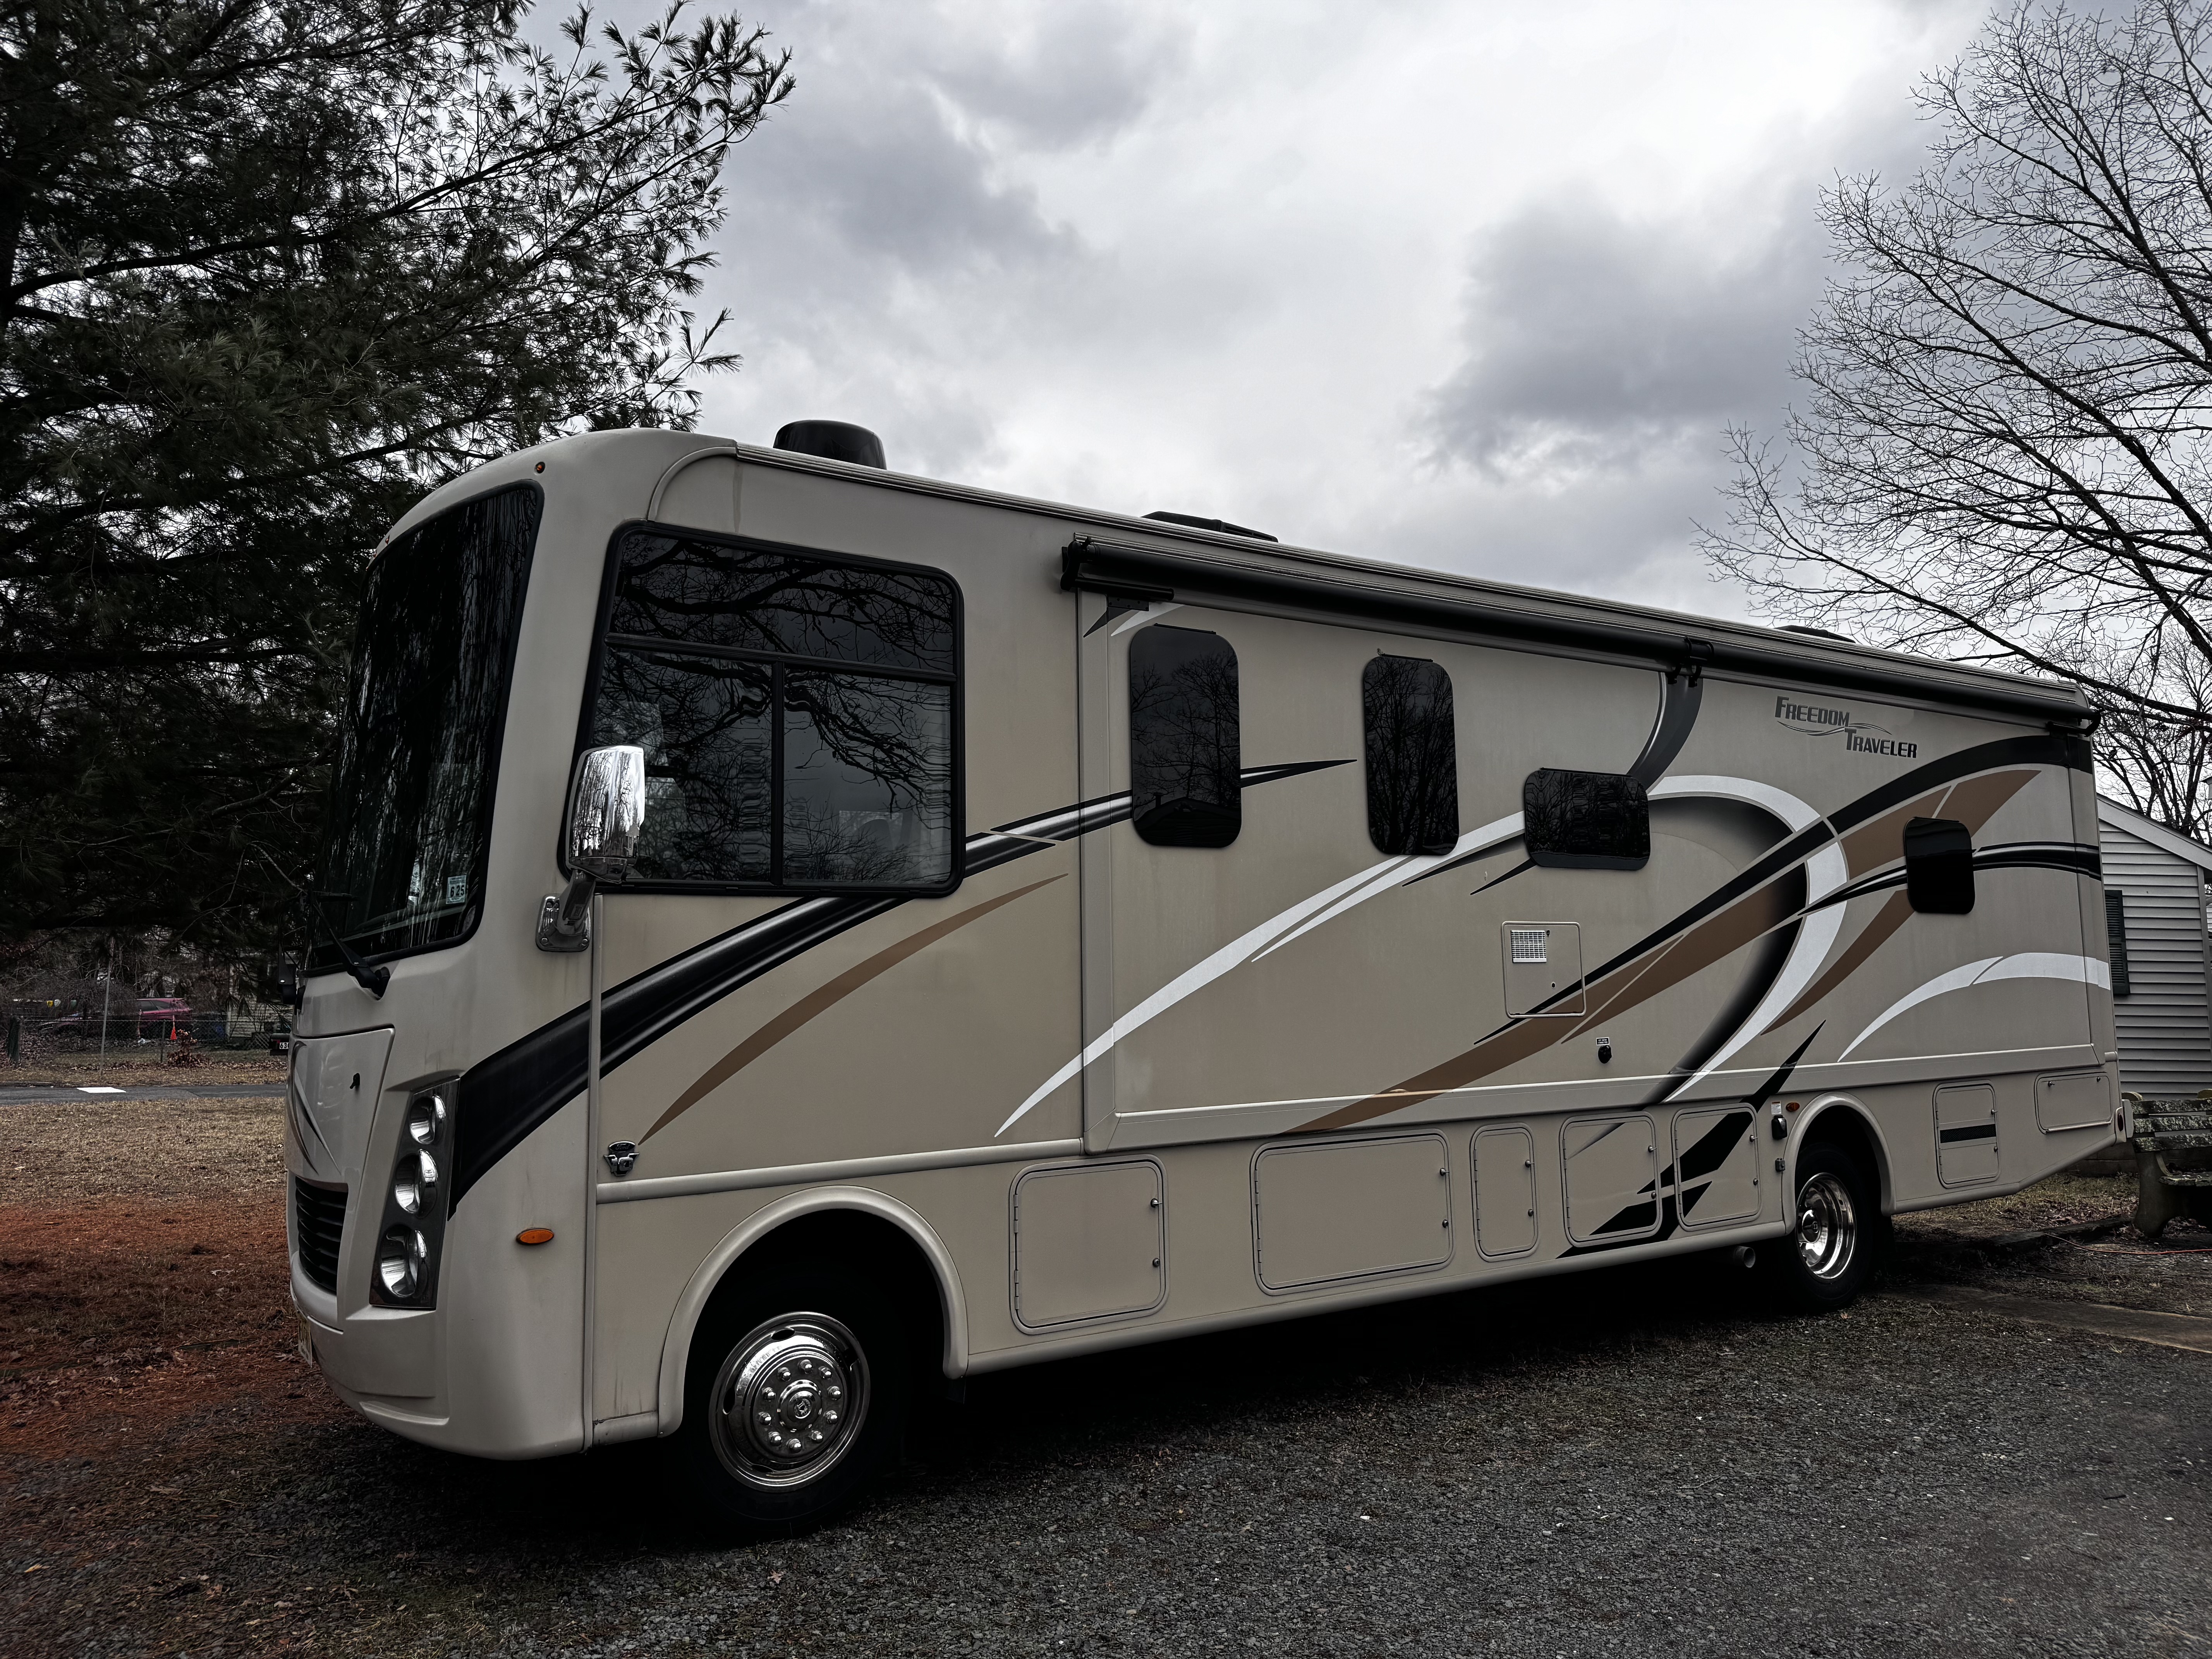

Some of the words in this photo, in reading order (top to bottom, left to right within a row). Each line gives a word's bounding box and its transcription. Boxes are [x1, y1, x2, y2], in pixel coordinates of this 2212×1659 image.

[1775, 696, 1850, 727] FREEDOM
[1844, 727, 1917, 758] TRAVELER
[450, 886, 454, 897] 6
[455, 885, 464, 896] 25
